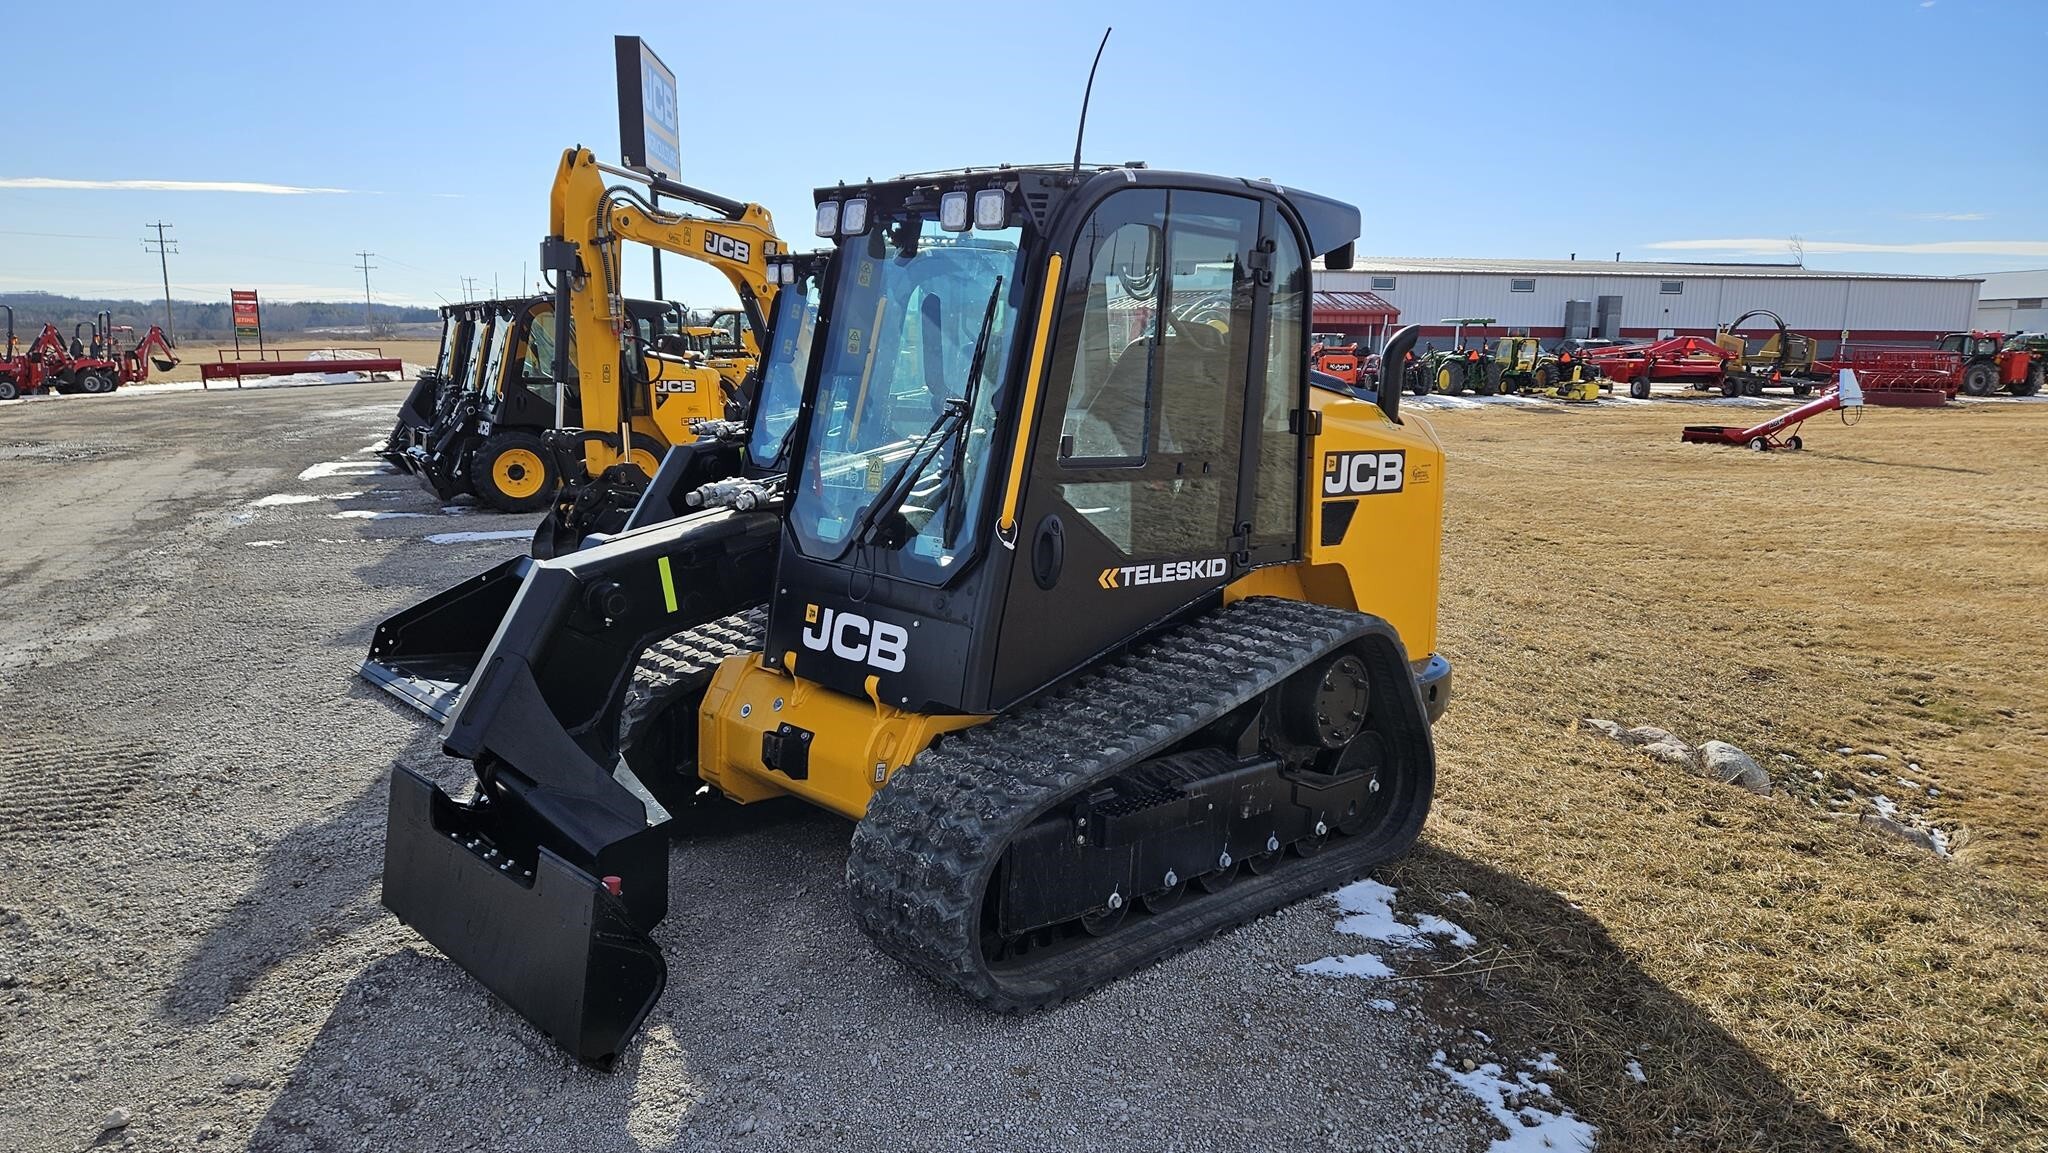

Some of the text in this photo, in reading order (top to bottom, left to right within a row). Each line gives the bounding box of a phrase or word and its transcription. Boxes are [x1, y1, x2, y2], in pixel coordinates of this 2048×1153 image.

[644, 66, 674, 130] JCB
[706, 234, 749, 263] JCB
[656, 381, 696, 392] JCB
[1324, 453, 1404, 494] JCB
[1120, 558, 1227, 587] TELESKID
[802, 607, 909, 673] JCB
